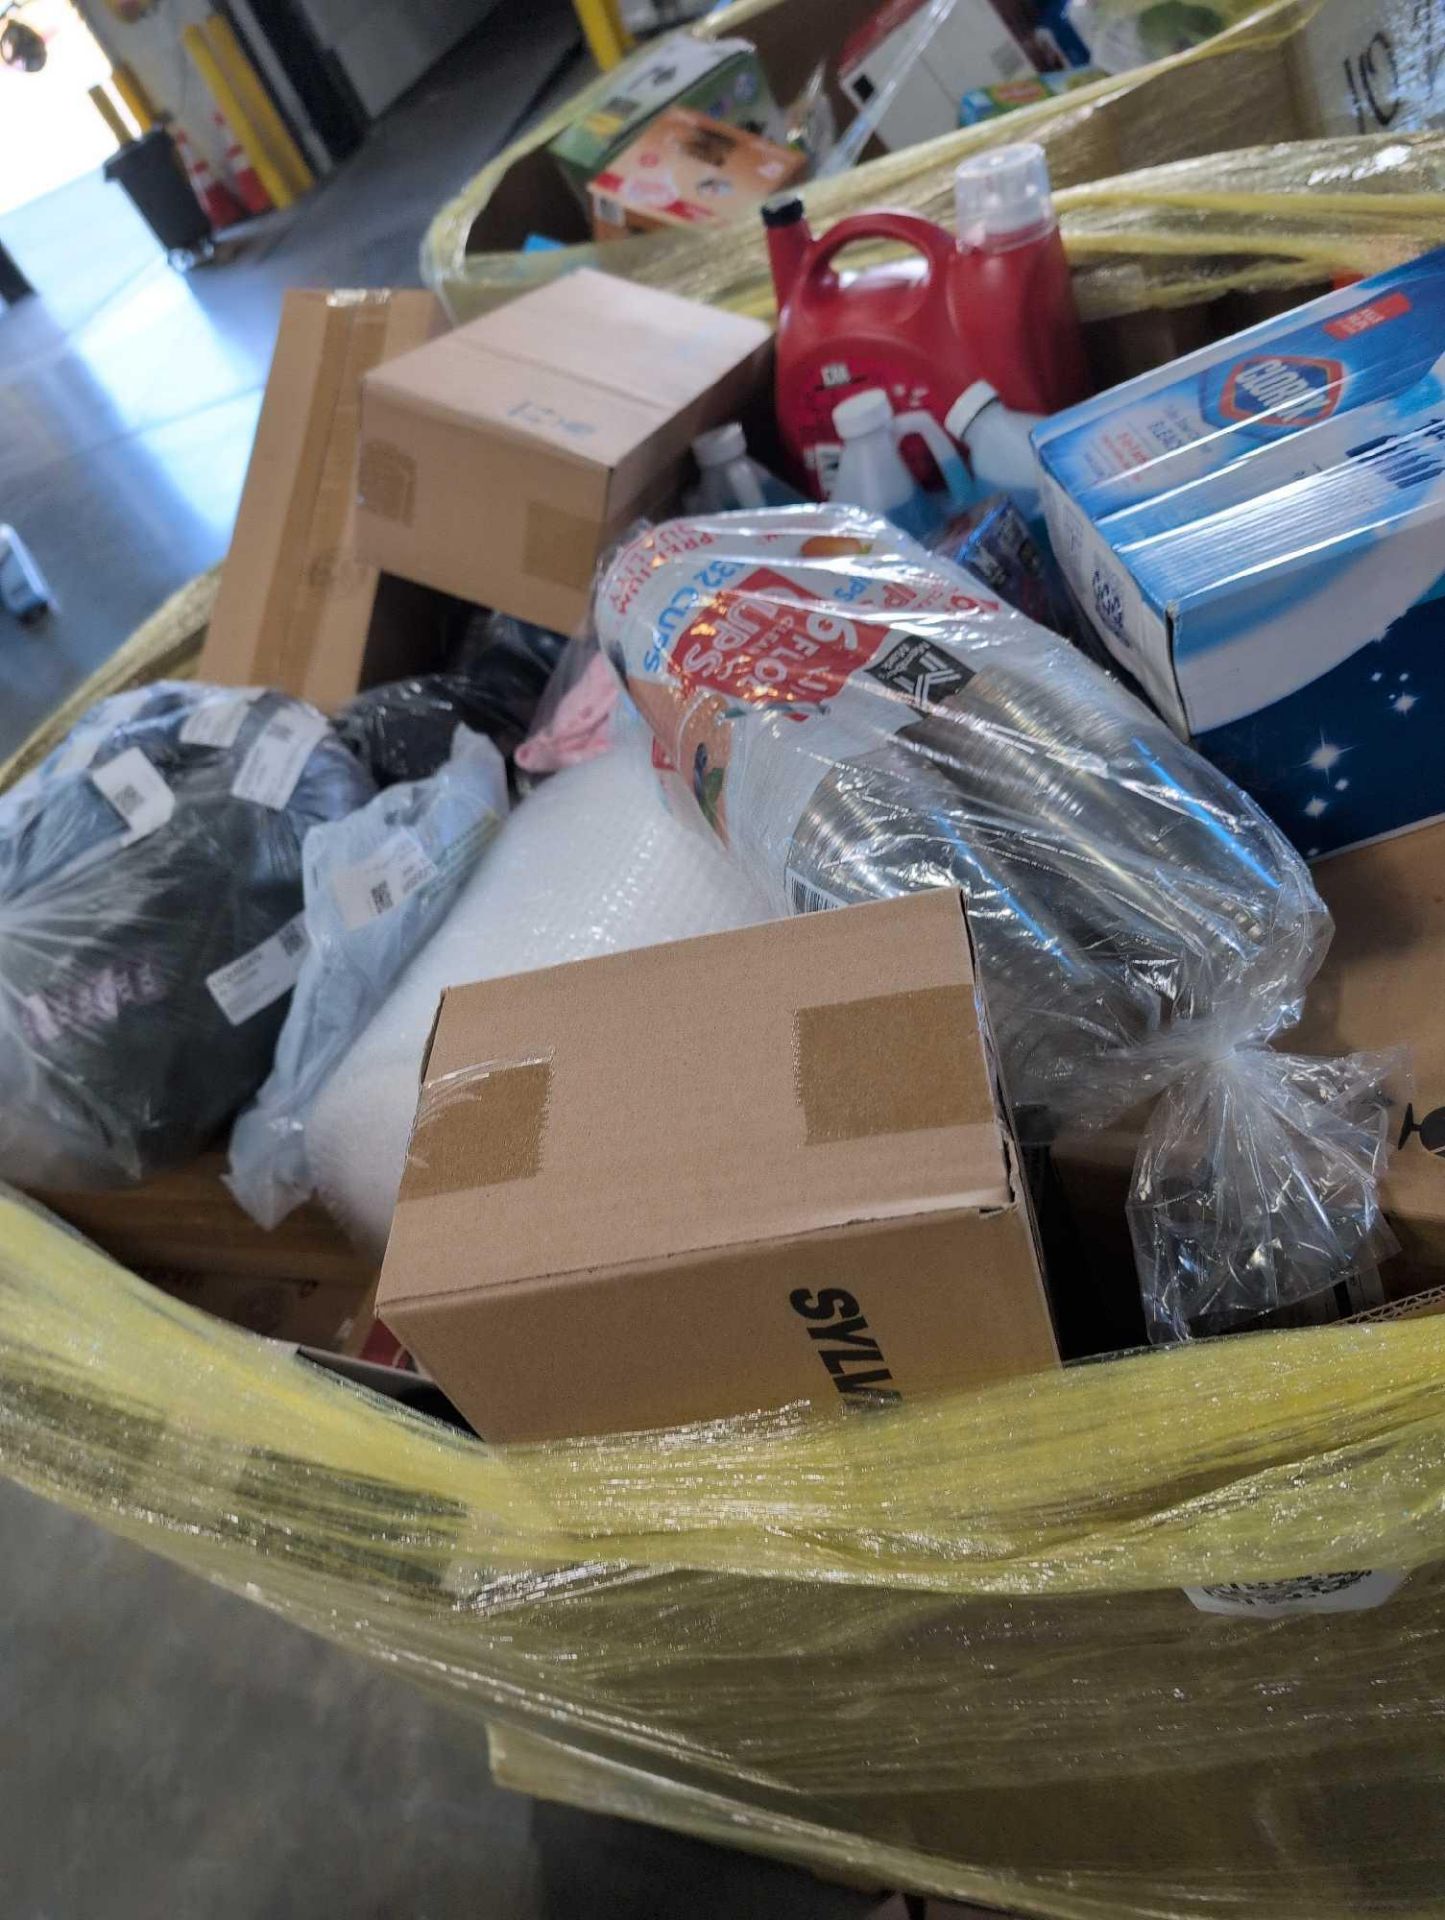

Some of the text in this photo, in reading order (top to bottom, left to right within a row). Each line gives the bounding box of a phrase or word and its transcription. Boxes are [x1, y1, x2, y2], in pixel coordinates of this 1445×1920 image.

[1235, 359, 1331, 423] CLOROX
[693, 560, 746, 587] 32
[643, 586, 699, 673] CUPS
[877, 640, 931, 681] Member's
[880, 643, 910, 670] Mark
[789, 1288, 904, 1409] SYLV
